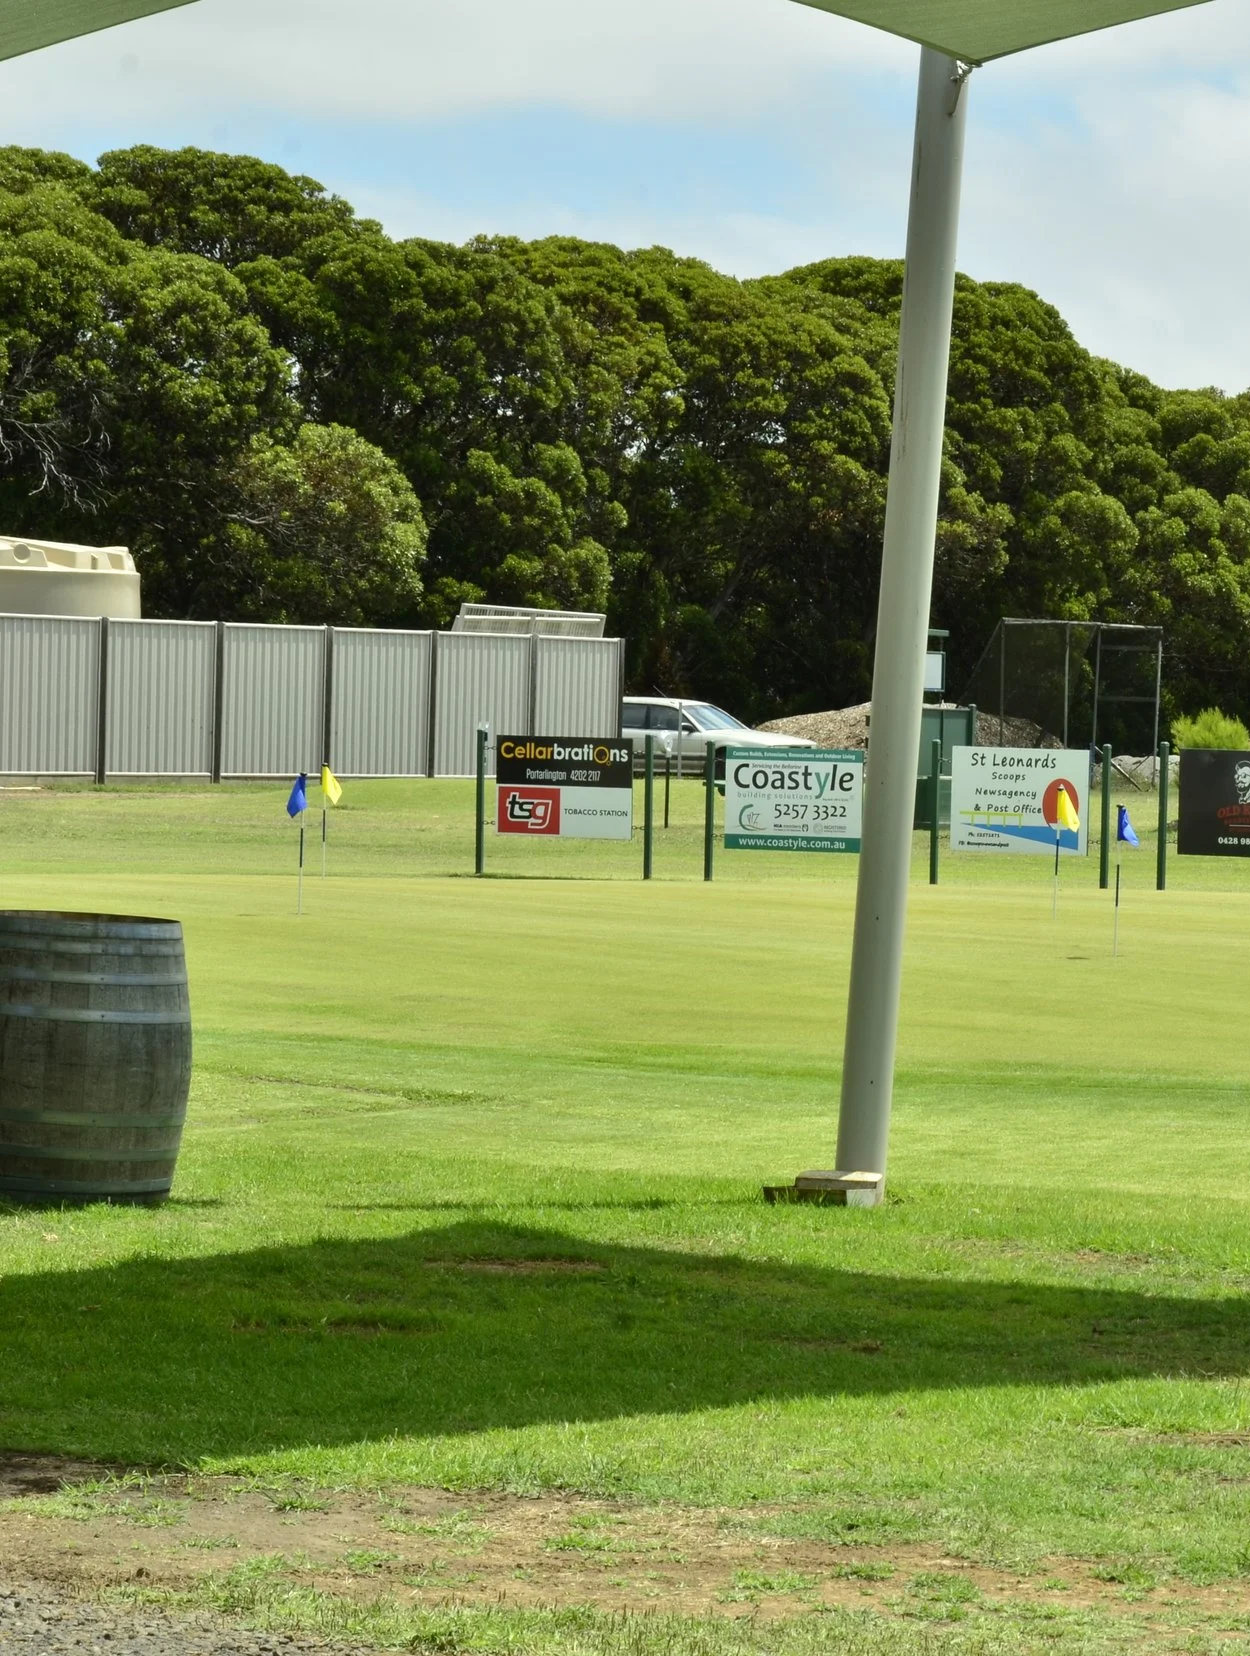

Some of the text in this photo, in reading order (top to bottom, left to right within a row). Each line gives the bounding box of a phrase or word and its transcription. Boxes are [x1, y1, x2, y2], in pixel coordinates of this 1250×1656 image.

[501, 742, 629, 764] Cellarbrations
[971, 753, 1057, 769] St Leonards
[526, 768, 600, 781] Portarlington 4202 2117
[992, 772, 1026, 783] Scoops
[733, 763, 855, 799] Coastyle
[737, 791, 771, 800] building
[774, 792, 813, 800] solutions
[975, 787, 1037, 799] Newsagency
[506, 792, 552, 828] tsg
[564, 808, 628, 817] TOBACCO STATION
[774, 804, 847, 821] 5257 3322
[974, 803, 1042, 814] & Post Office
[1217, 806, 1240, 818] OLD
[738, 837, 845, 850] www.coastyle.com.au
[1218, 836, 1238, 845] 0428
